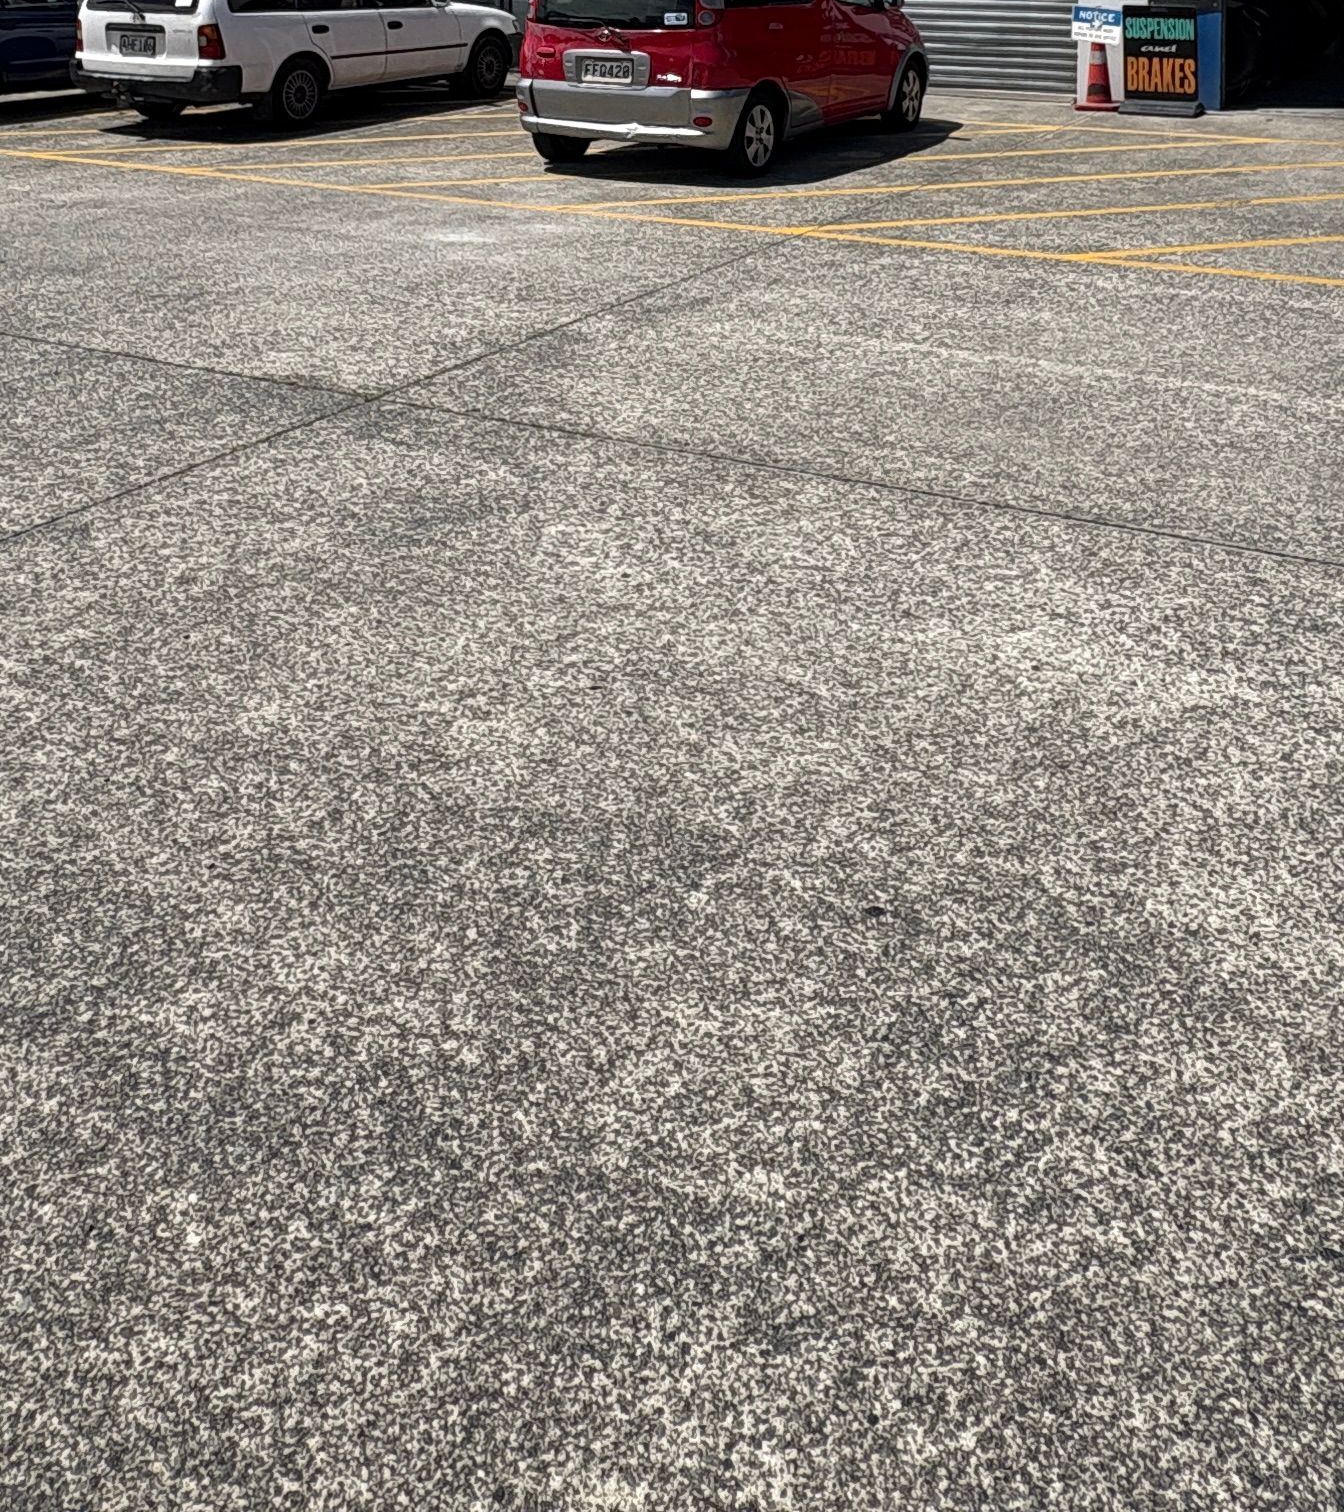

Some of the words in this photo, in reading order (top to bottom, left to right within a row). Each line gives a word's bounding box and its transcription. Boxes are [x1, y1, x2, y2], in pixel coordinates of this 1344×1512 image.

[1078, 10, 1116, 23] NOTICE
[1125, 16, 1195, 41] SUSPENSION
[1140, 44, 1177, 53] and
[1126, 56, 1197, 95] BRAKES
